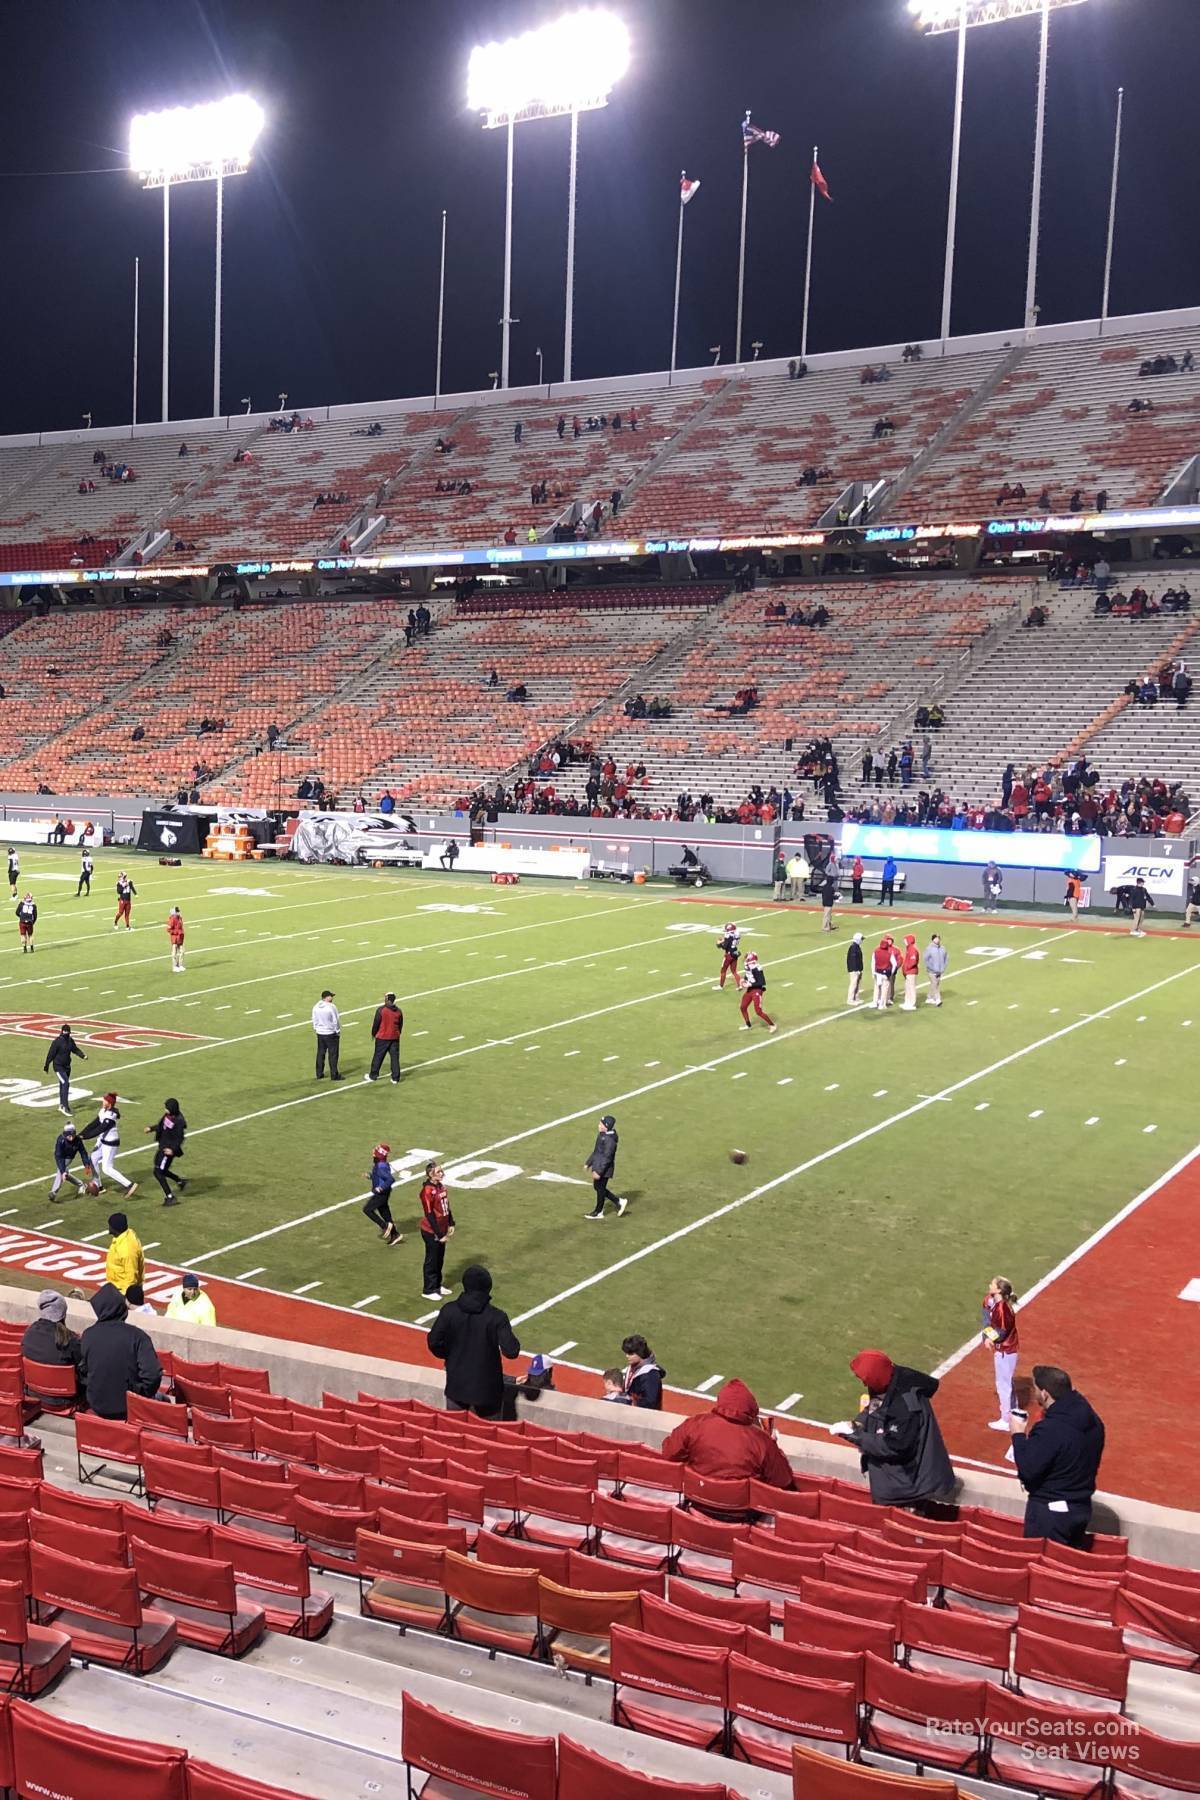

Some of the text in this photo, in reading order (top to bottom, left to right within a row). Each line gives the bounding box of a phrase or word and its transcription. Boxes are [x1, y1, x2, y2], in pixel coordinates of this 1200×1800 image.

[865, 524, 981, 541] Switch to Solar Power
[988, 521, 1014, 533] Own
[1016, 519, 1044, 532] Your
[645, 541, 665, 552] Own
[667, 540, 688, 551] Your
[689, 538, 720, 551] Power
[236, 564, 261, 574] Switch
[318, 559, 335, 569] Own
[337, 558, 354, 568] Your
[1163, 844, 1173, 856] 7
[1122, 866, 1174, 878] ACCN
[388, 1148, 524, 1189] 10
[620, 1671, 722, 1702] www.wolfpackcushion.com
[736, 1702, 844, 1736] www.wolfpackcushion.com
[419, 1754, 530, 1799] www.wolfpackcushion.com
